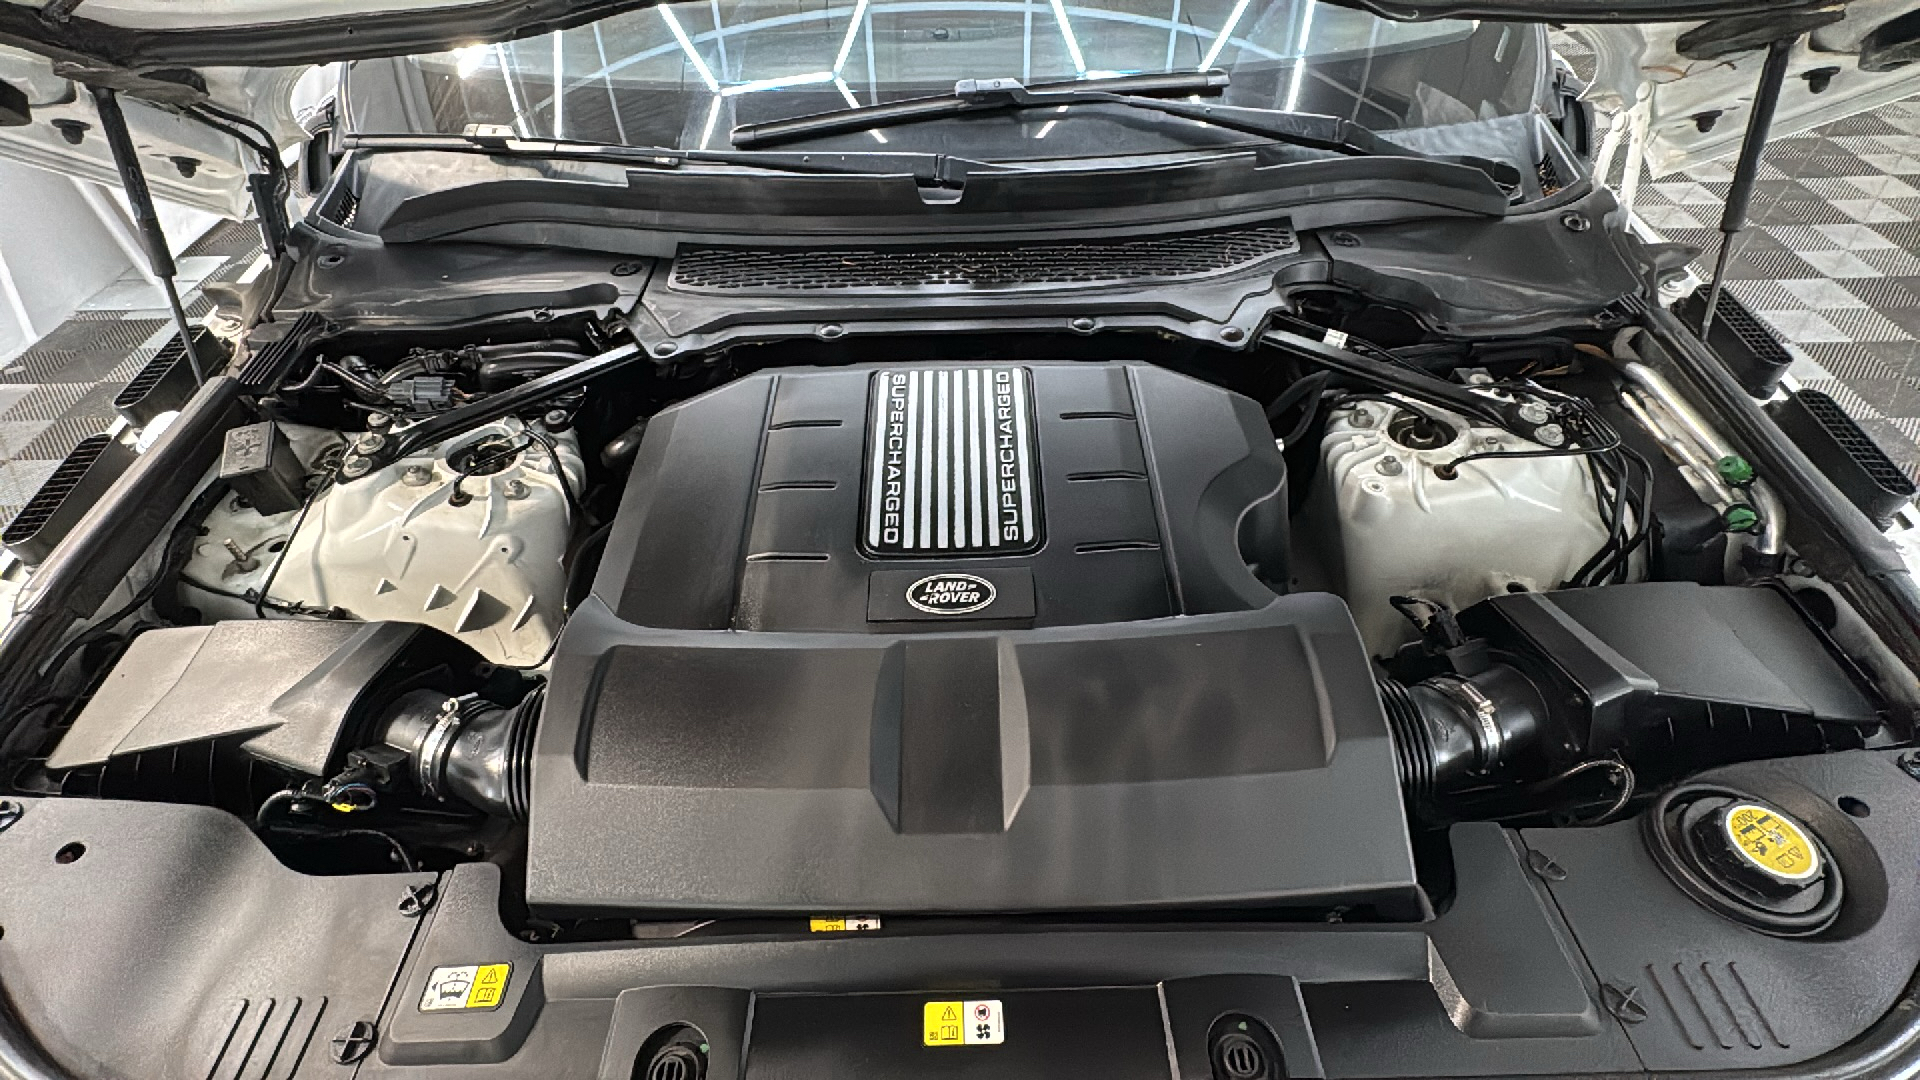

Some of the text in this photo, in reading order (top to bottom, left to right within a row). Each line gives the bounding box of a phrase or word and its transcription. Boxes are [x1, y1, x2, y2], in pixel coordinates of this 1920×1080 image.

[883, 373, 907, 544] SUPERCHARGED
[995, 371, 1019, 541] SUPERCHARGED
[925, 581, 968, 593] LAND
[927, 591, 981, 604] ROVER
